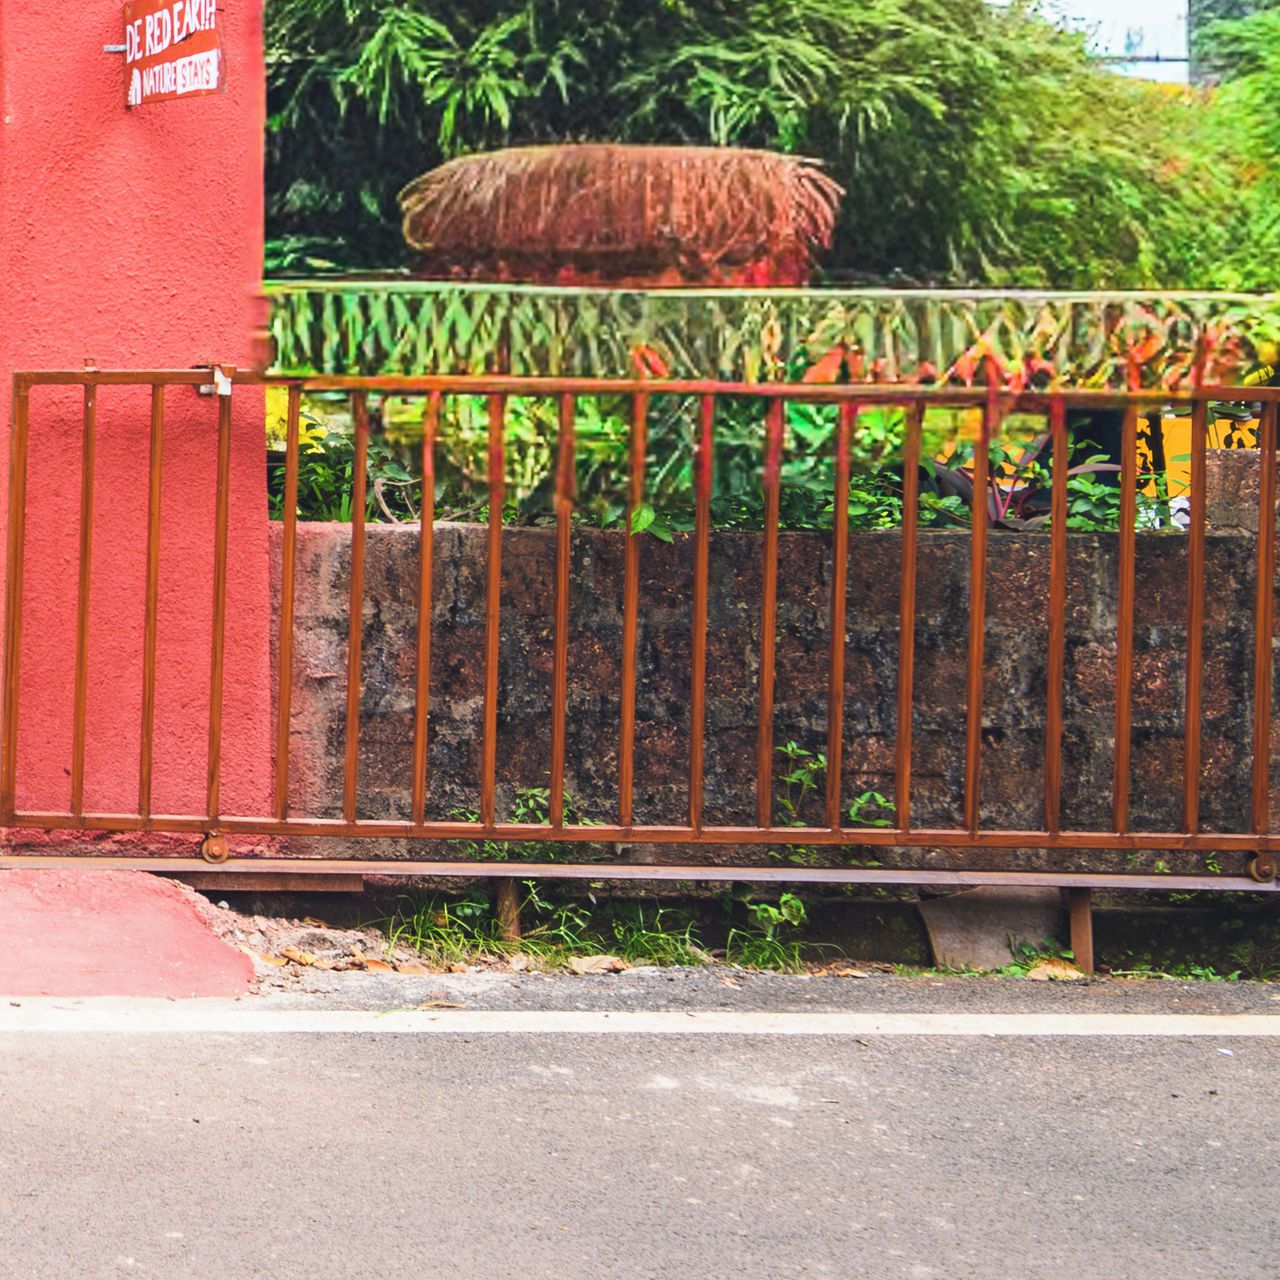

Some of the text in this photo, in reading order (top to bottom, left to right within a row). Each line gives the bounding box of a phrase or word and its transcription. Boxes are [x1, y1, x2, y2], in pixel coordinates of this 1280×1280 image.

[126, 19, 142, 64] DE
[145, 8, 172, 57] RED
[143, 57, 212, 97] NATURE STAYS
